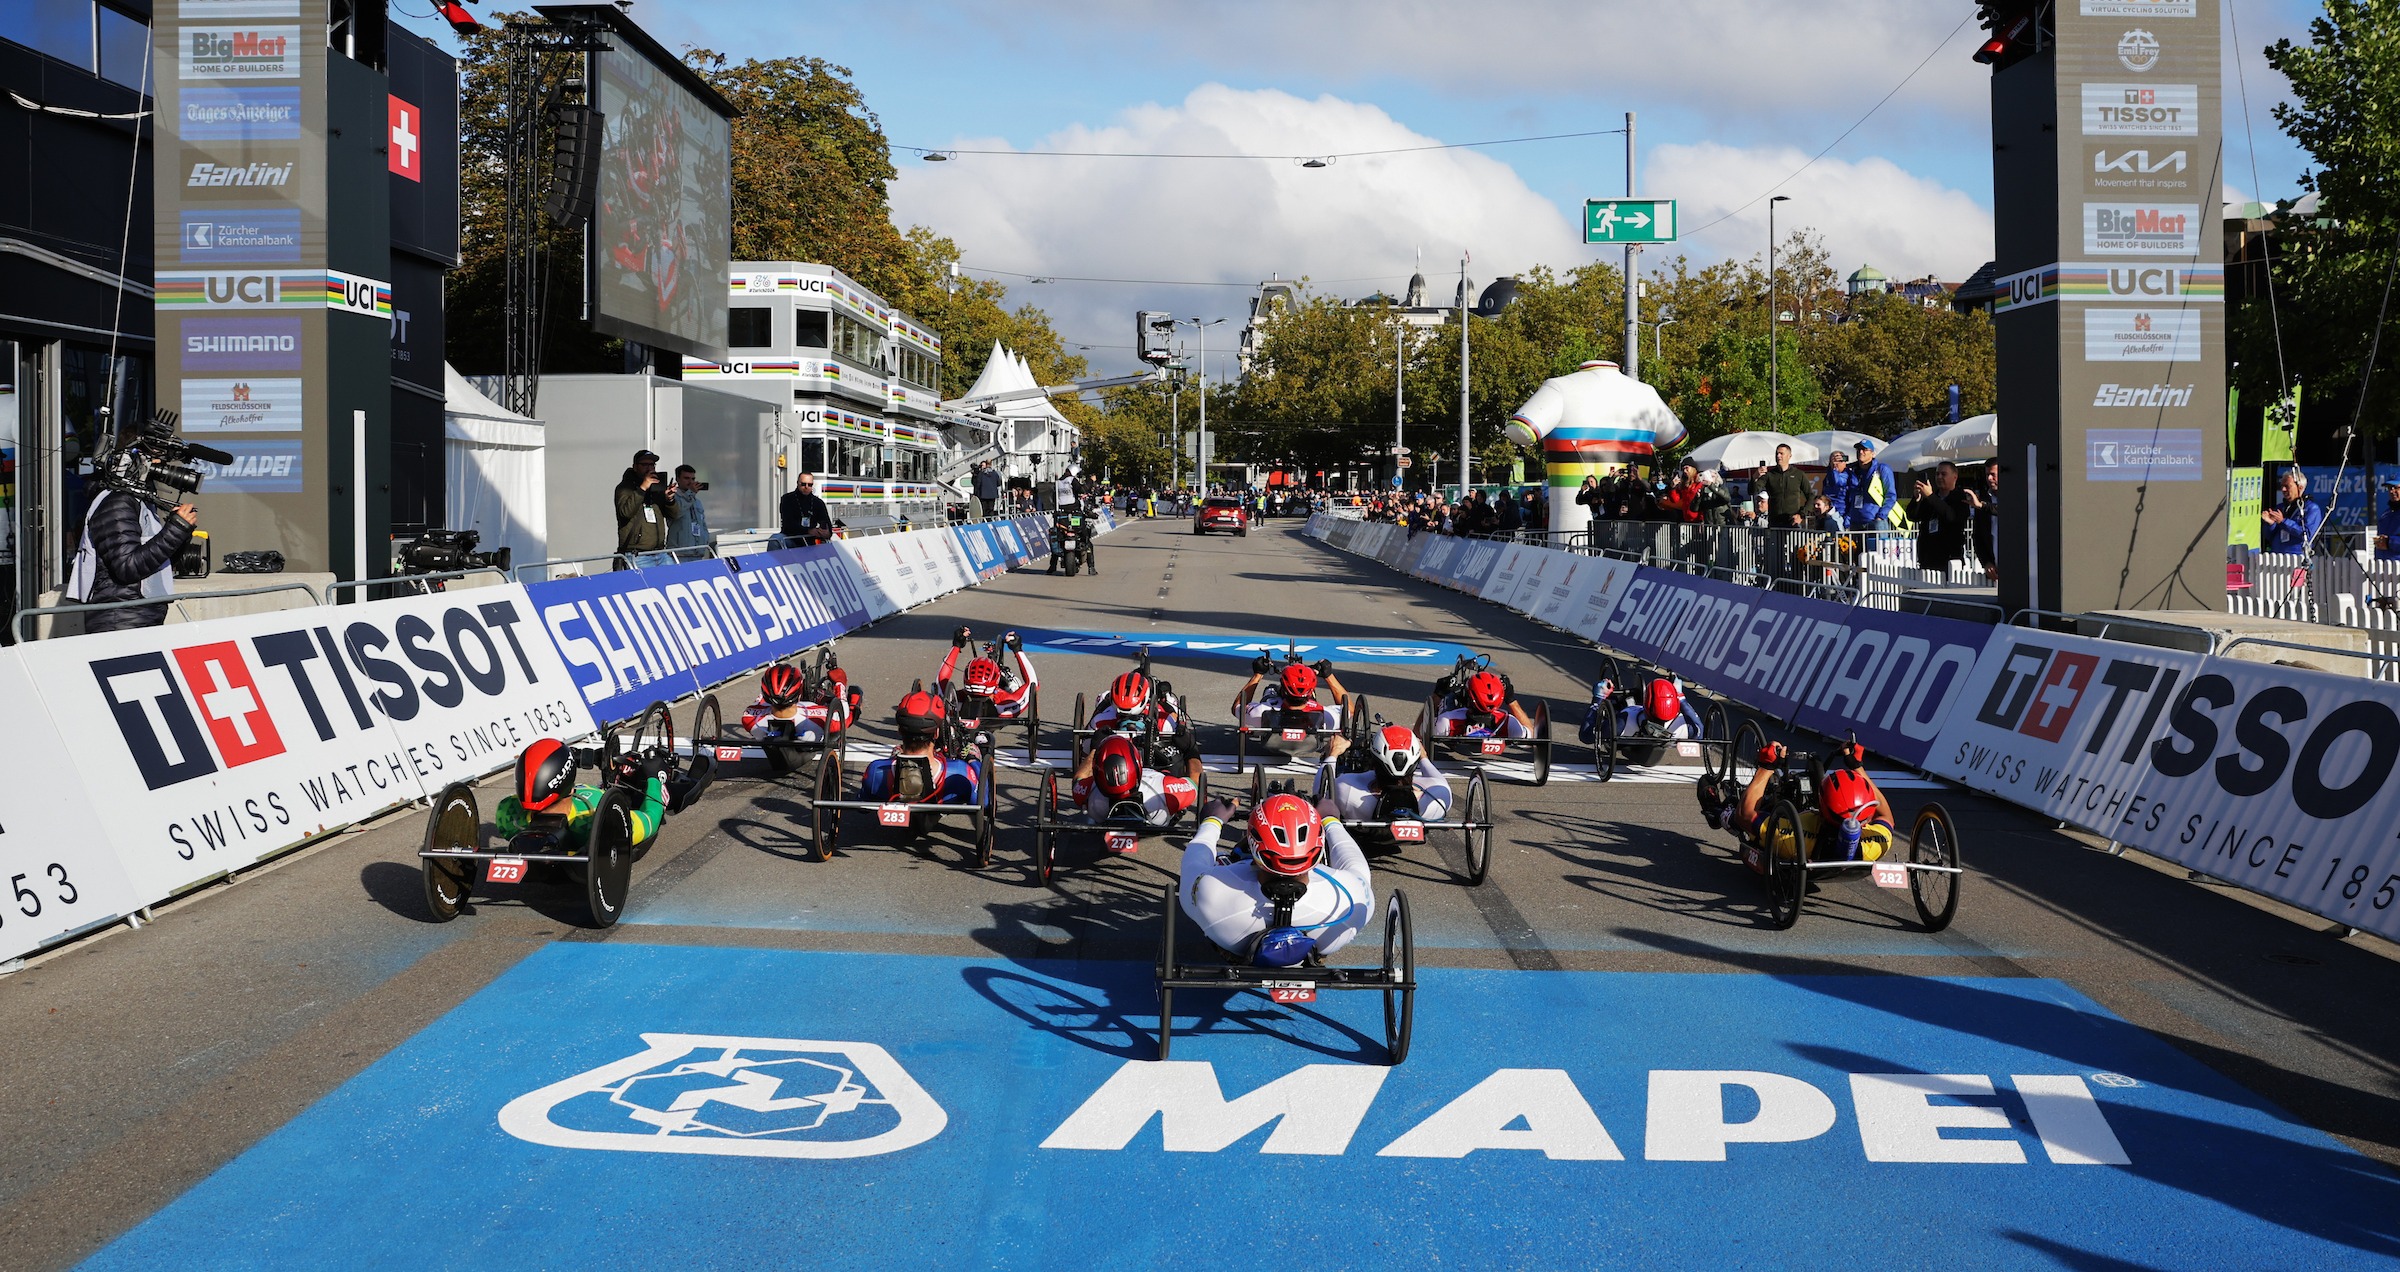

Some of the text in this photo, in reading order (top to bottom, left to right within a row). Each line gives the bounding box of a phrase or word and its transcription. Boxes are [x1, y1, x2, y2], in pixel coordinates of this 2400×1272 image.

[192, 31, 286, 65] BigMat
[2118, 46, 2160, 57] Emil Frey
[192, 64, 284, 73] HOME OF BUILDERS
[2098, 107, 2181, 123] TISSOT
[2094, 149, 2187, 173] KIA
[187, 162, 293, 188] Santini
[2094, 179, 2187, 189] Movement that inspires
[218, 223, 260, 236] Zürcher
[2096, 209, 2186, 239] BigMat
[218, 233, 293, 247] Kantonalbank
[2096, 241, 2184, 249] HOME OF BUILDERS
[799, 279, 824, 293] UCI
[2011, 273, 2040, 305] UCI
[2110, 269, 2174, 295] UCI
[207, 276, 275, 304] UCI
[345, 281, 375, 312] UCI
[188, 335, 295, 353] SHIMANO
[2114, 333, 2172, 341] FELDSCHLÖSSCHEN
[2122, 343, 2164, 357] Alkoholfrei
[721, 362, 749, 374] UCI
[2093, 383, 2194, 407] Santini
[211, 401, 271, 410] FELDSCHLÖSSCHEN
[219, 413, 264, 427] Alkoholfrei
[2123, 445, 2163, 455] Zürcher
[221, 455, 294, 477] MAPEI
[2123, 454, 2194, 465] Kantonalbank
[2313, 474, 2352, 493] Zürich
[737, 556, 863, 642] SHIMANO
[1607, 577, 1752, 679] SHIMANO
[544, 570, 762, 705] SHIMANO
[251, 600, 539, 742] TISSOT
[1732, 608, 1978, 743] SHIMANO
[720, 749, 738, 760] 277
[1484, 744, 1501, 752] 279
[1681, 746, 1697, 754] 274
[2084, 659, 2400, 838] TISSO
[548, 752, 575, 789] RUDY
[168, 699, 573, 861] SWISS WATCHES SINCE 1853
[1954, 740, 2027, 785] SWISS
[2034, 765, 2166, 832] WATCHES
[2180, 814, 2303, 878] SINCE
[883, 812, 906, 823] 283
[1397, 827, 1419, 838] 275
[1111, 838, 1134, 849] 278
[492, 866, 518, 879] 273
[1879, 872, 1903, 885] 282
[1278, 989, 1310, 1000] 276
[1037, 1060, 2131, 1166] MAPEI
